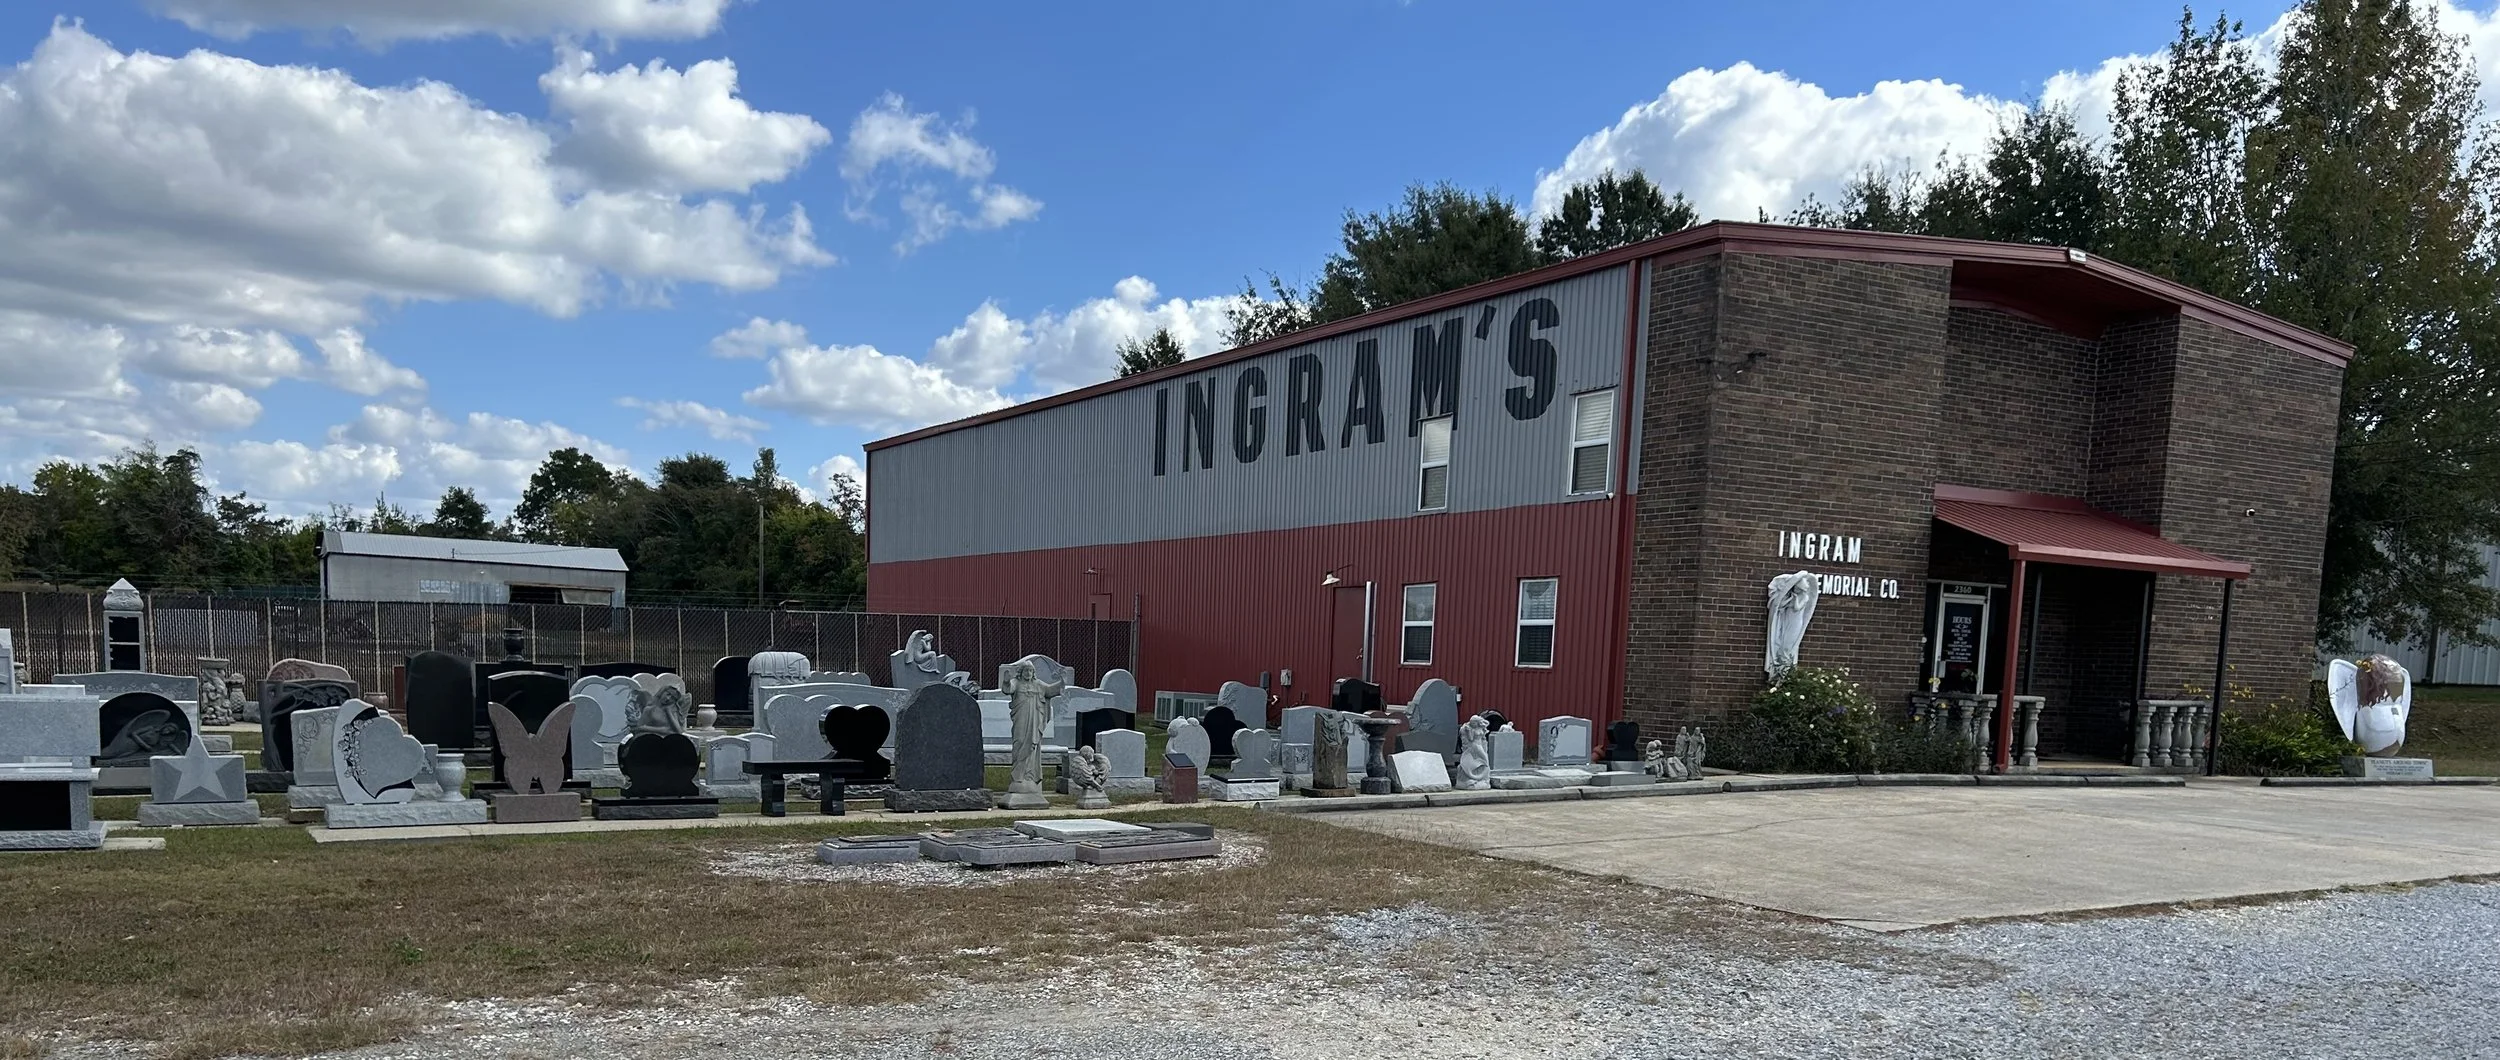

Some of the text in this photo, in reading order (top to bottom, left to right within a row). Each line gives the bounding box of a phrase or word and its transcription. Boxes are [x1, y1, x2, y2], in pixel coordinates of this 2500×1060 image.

[1153, 297, 1560, 477] INGRAM'S
[1778, 530, 1862, 564] INGRAM
[1815, 573, 1900, 600] EMORIAL CO.
